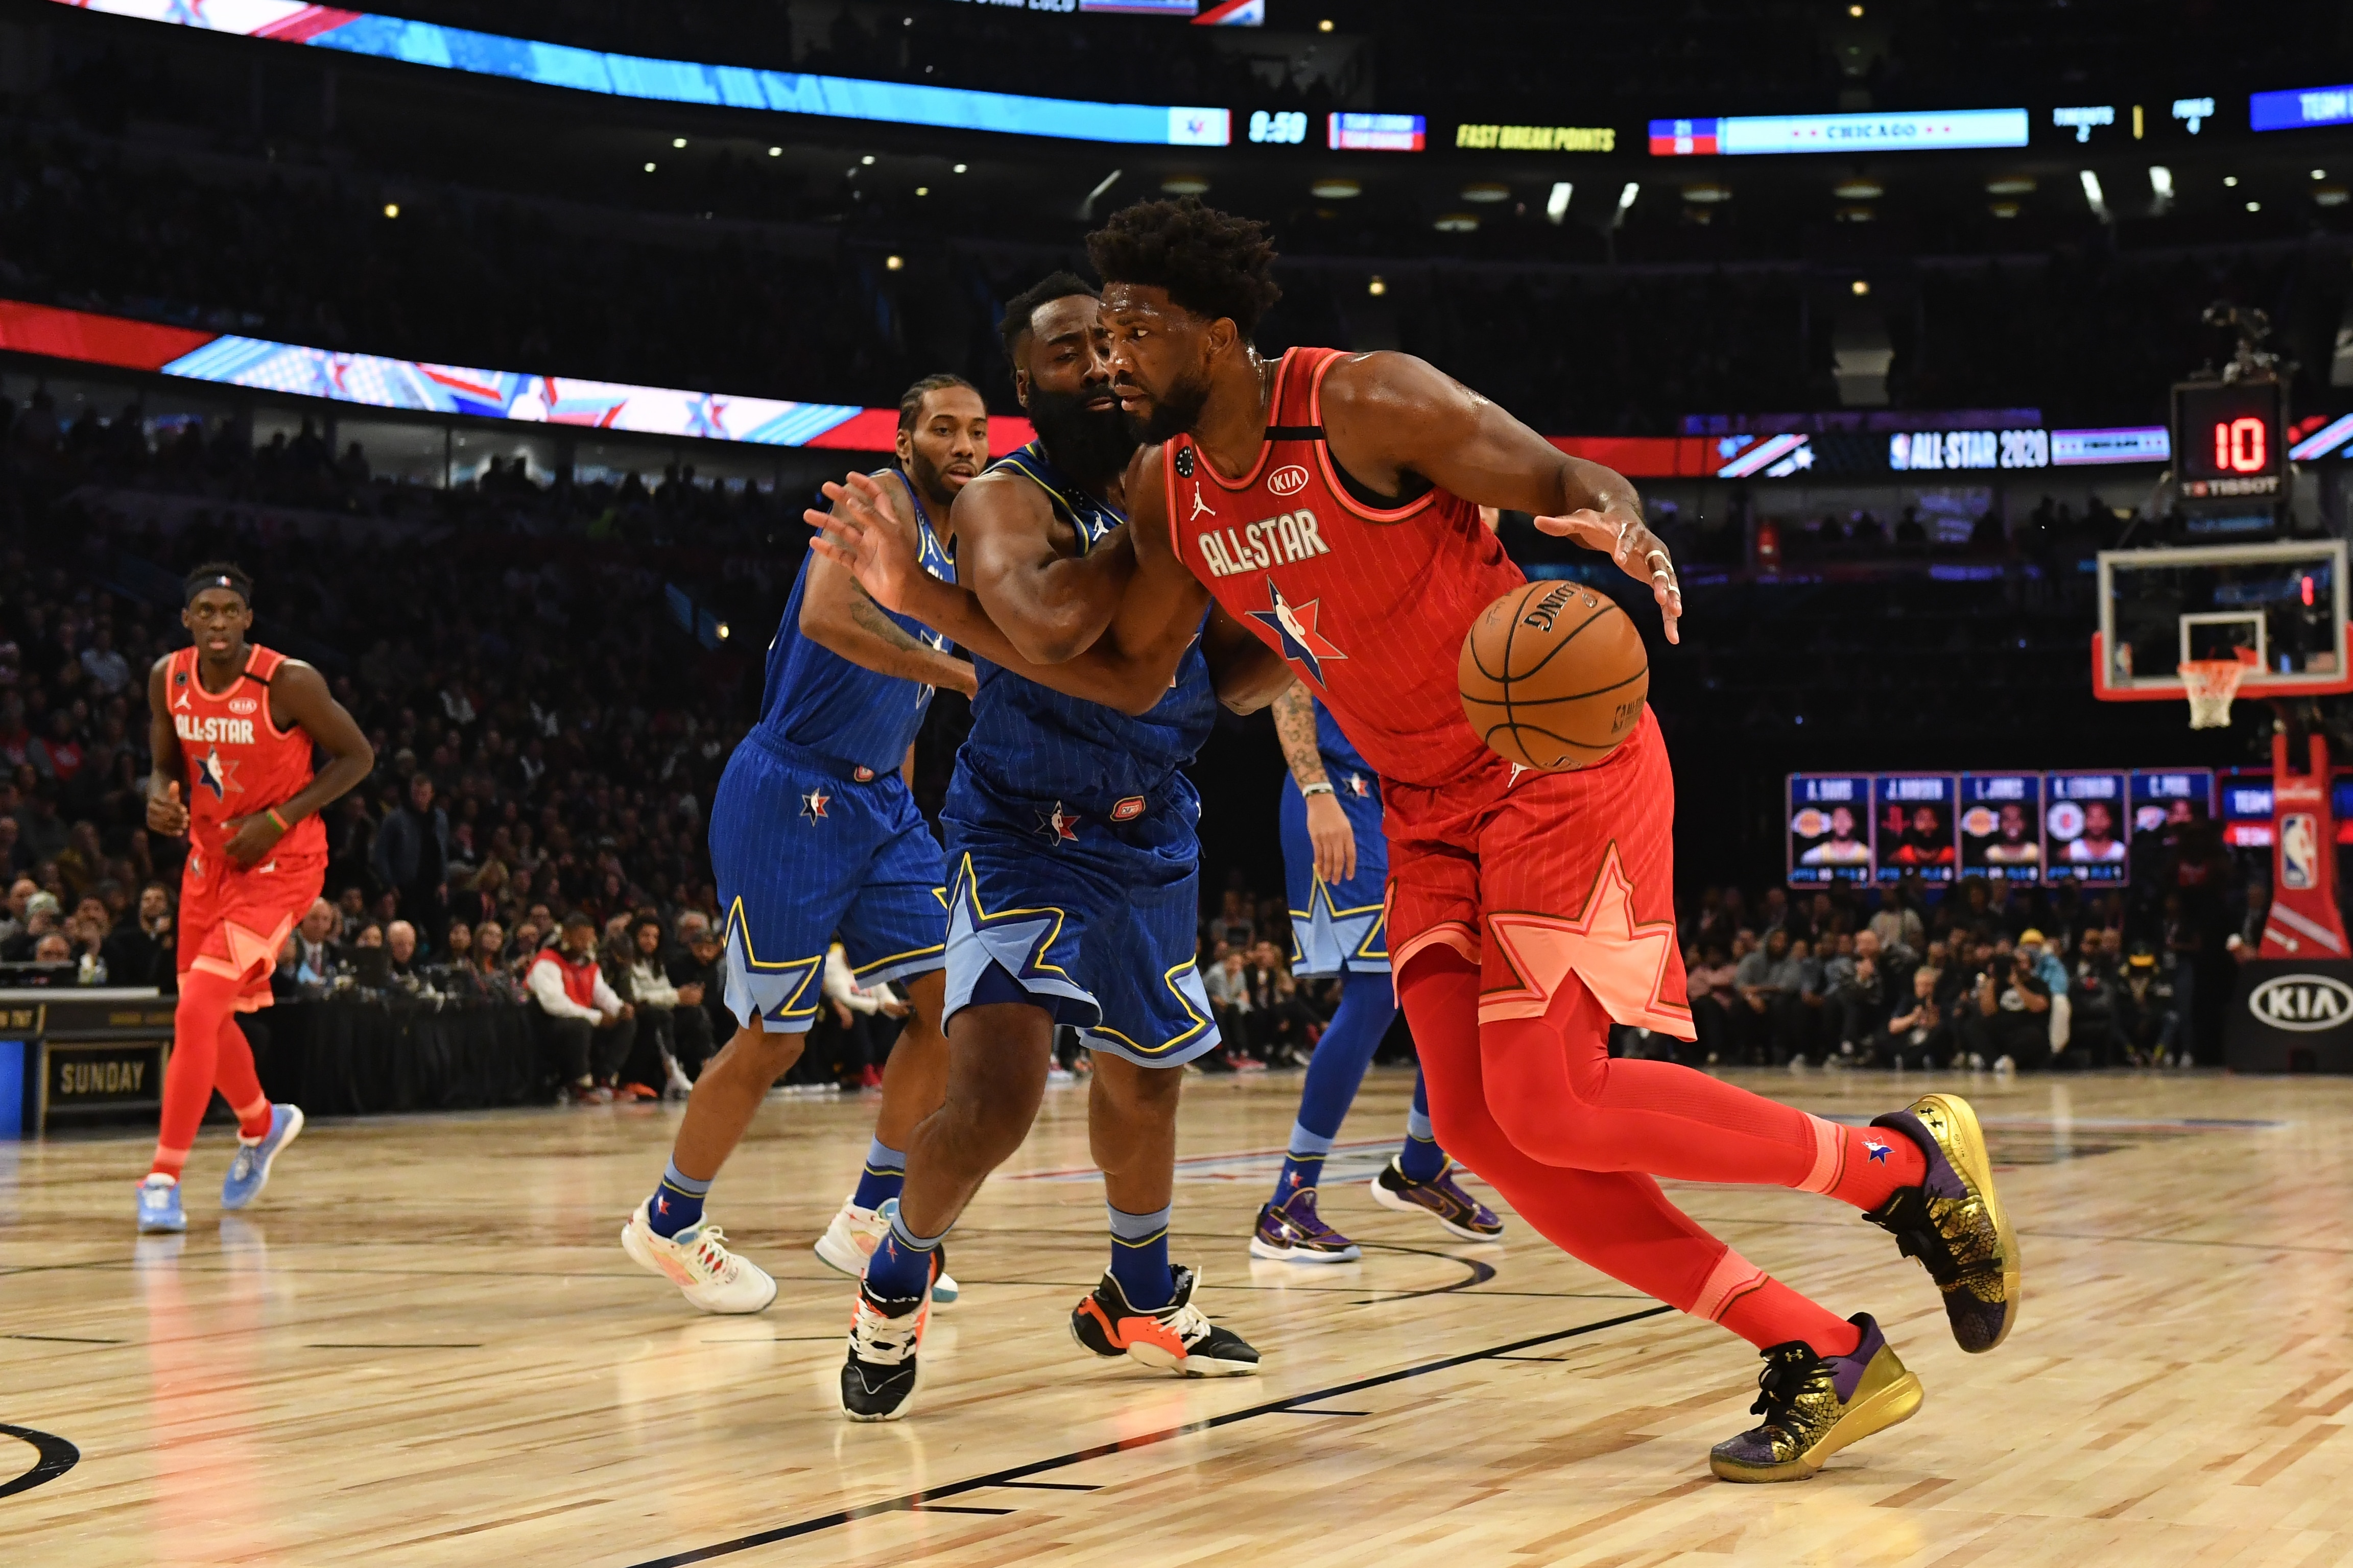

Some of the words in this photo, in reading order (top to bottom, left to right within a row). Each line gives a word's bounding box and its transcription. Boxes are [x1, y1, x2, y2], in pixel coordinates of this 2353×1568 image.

[1455, 124, 1500, 148] FAST
[1499, 126, 1554, 150] BREAK
[1553, 128, 1615, 152] POINTS
[1826, 124, 1917, 139] CHICAGO
[1911, 431, 1998, 469] ALL-STAR
[2000, 429, 2049, 469] 2020
[2215, 417, 2266, 473] 10
[1274, 471, 1302, 491] KIA
[1198, 508, 1330, 577] ALL-STAR
[232, 699, 253, 712] KIA
[175, 713, 254, 744] ALL-STAR
[2268, 985, 2341, 1020] KIA
[61, 1062, 144, 1094] SUNDAY
